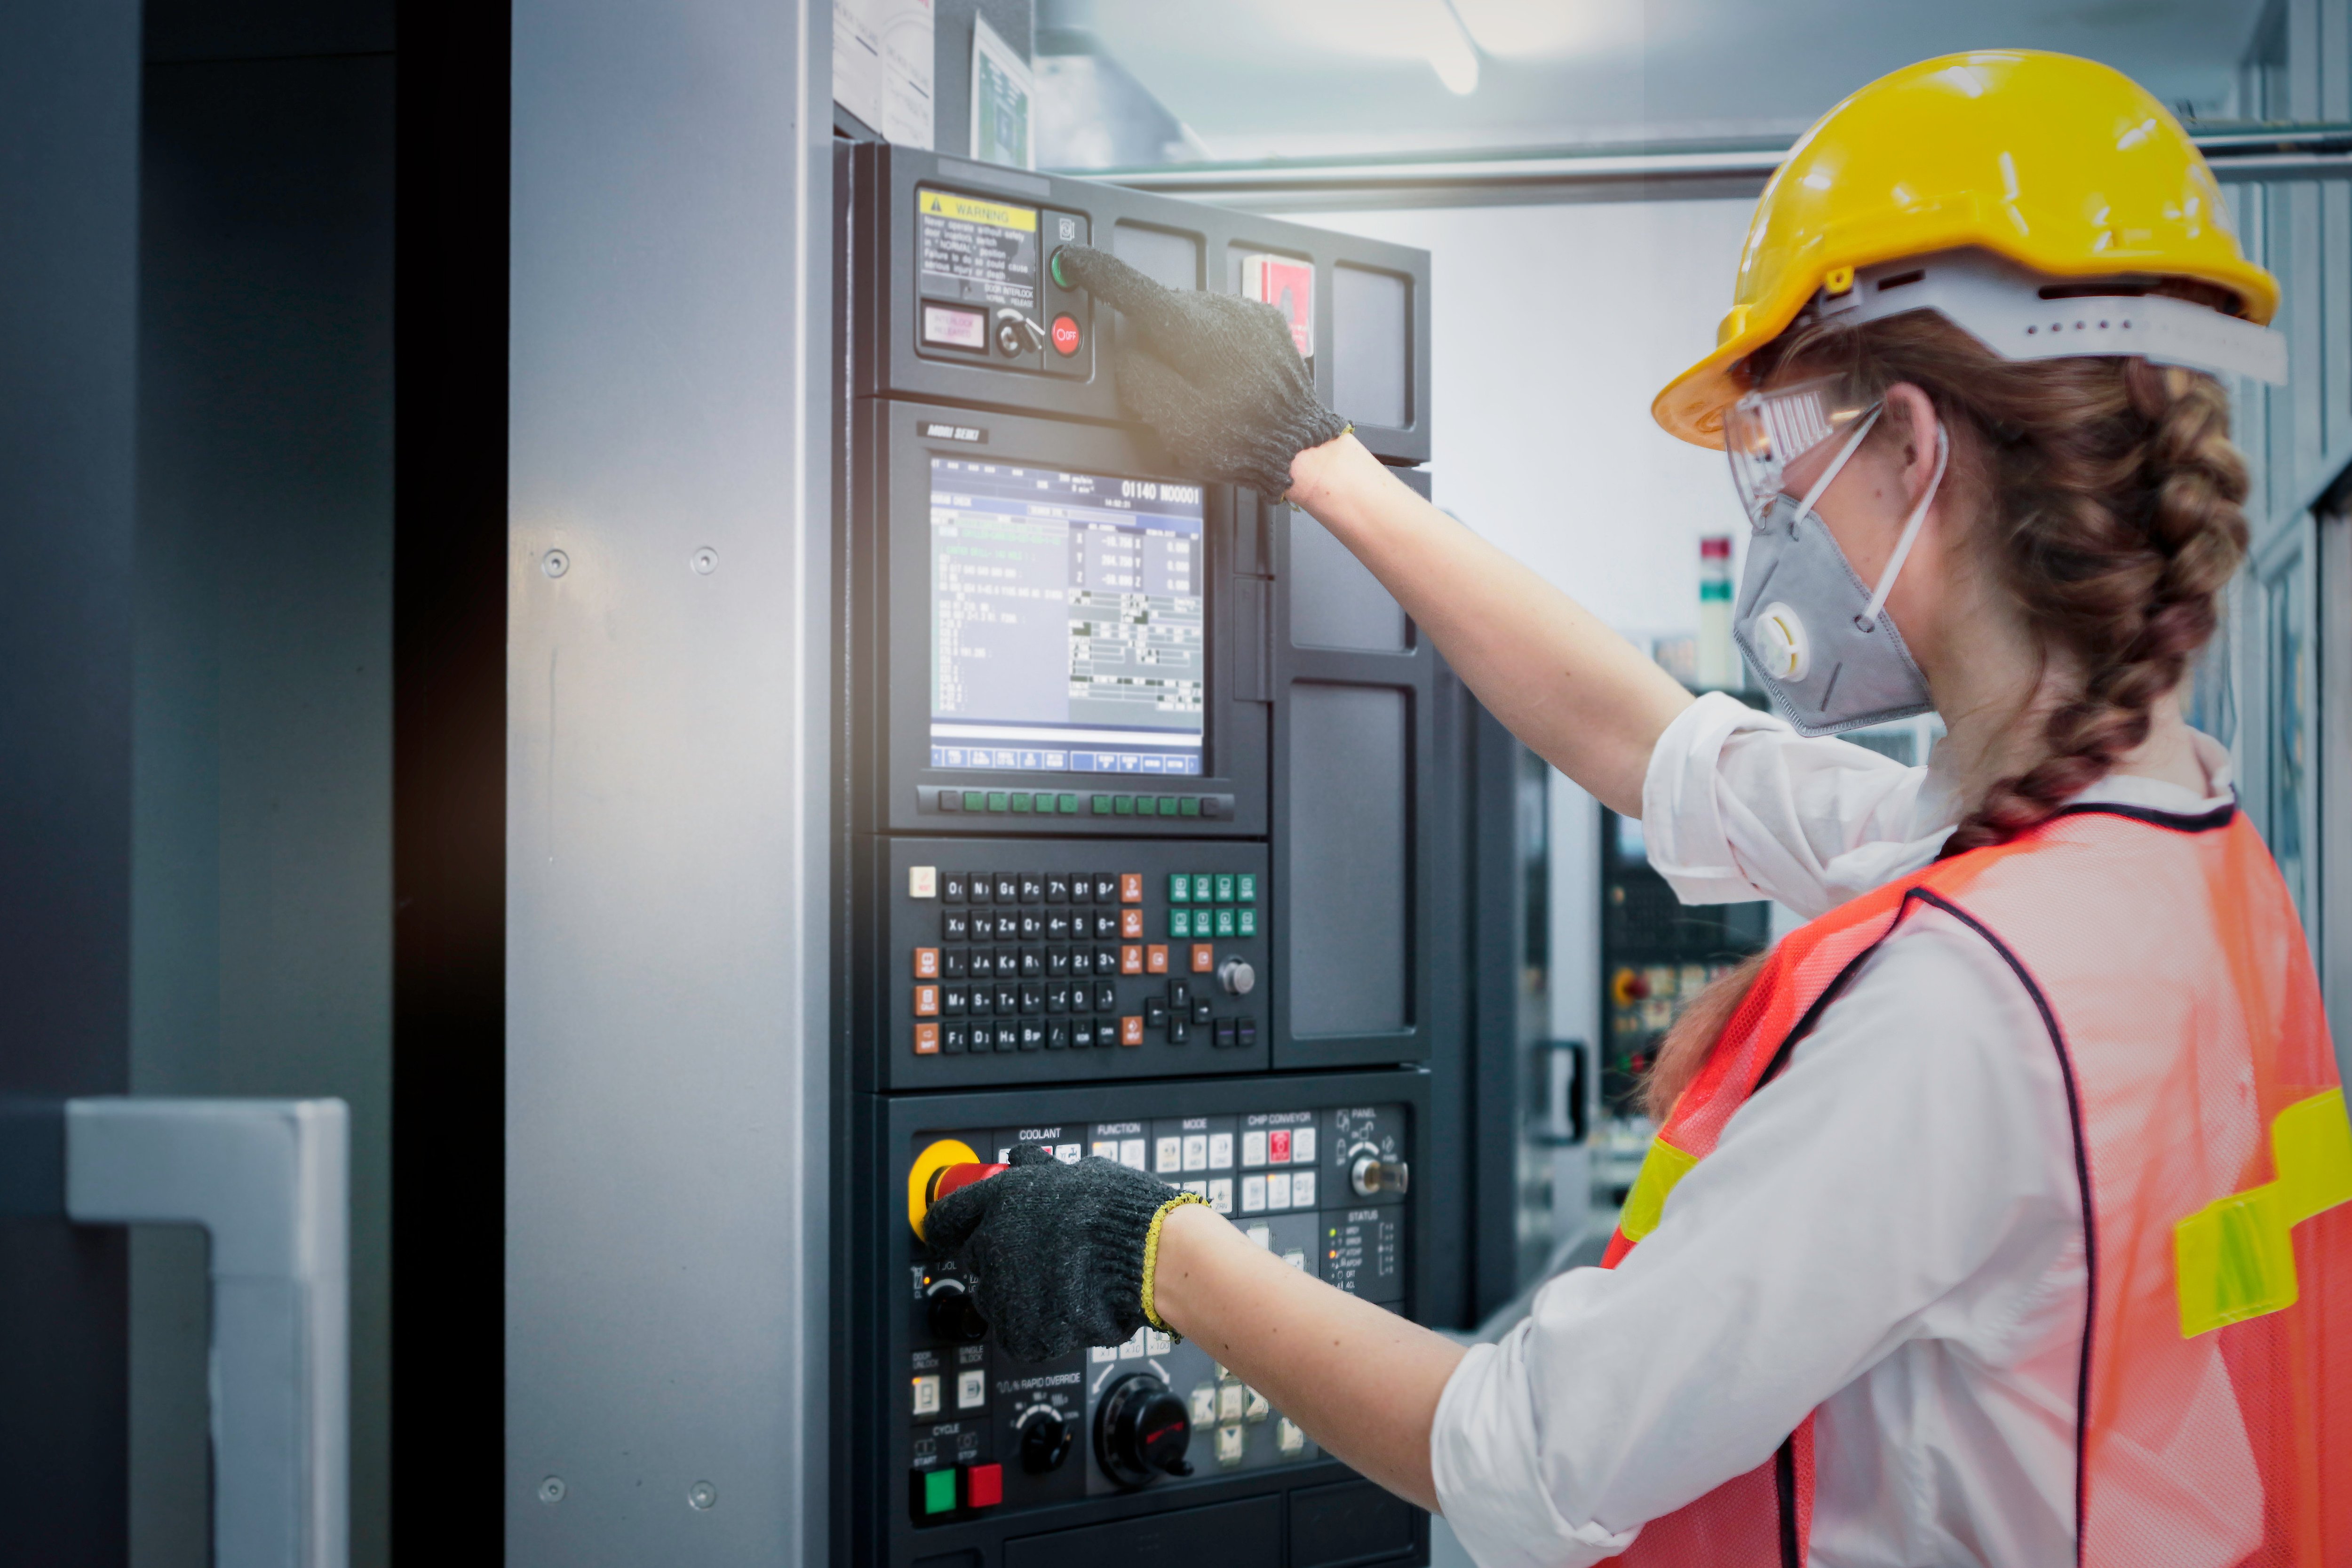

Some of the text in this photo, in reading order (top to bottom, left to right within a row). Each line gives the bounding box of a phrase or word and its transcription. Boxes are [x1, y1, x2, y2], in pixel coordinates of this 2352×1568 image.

[956, 203, 1009, 223] WARNING
[924, 215, 1025, 244] Never operate without safety
[924, 227, 941, 237] door
[924, 248, 949, 261] Failure
[952, 253, 959, 262] to
[962, 255, 972, 264] do
[986, 260, 1005, 270] could
[1008, 263, 1028, 274] cause
[953, 265, 972, 277] injury
[984, 284, 1034, 298] DOOR INTERLOCK
[927, 423, 979, 441] MORI SEIKI
[1074, 918, 1083, 931] 5
[1248, 1112, 1311, 1126] CHIP CONVEYOR
[1351, 1107, 1376, 1119] PANEL
[1097, 1122, 1142, 1136] FUNCTION
[1183, 1118, 1208, 1130] MODE
[1019, 1128, 1062, 1140] COOLANT
[1348, 1210, 1379, 1223] STATUS
[912, 1351, 932, 1361] DOOR
[960, 1345, 984, 1355] SINGLE
[913, 1359, 939, 1370] UNLOCK
[960, 1353, 983, 1364] BLOCK
[1021, 1377, 1044, 1389] RAPID
[1045, 1372, 1081, 1387] OVERRIDE
[932, 1423, 960, 1436] CYCLE
[914, 1449, 977, 1467] START STOP
